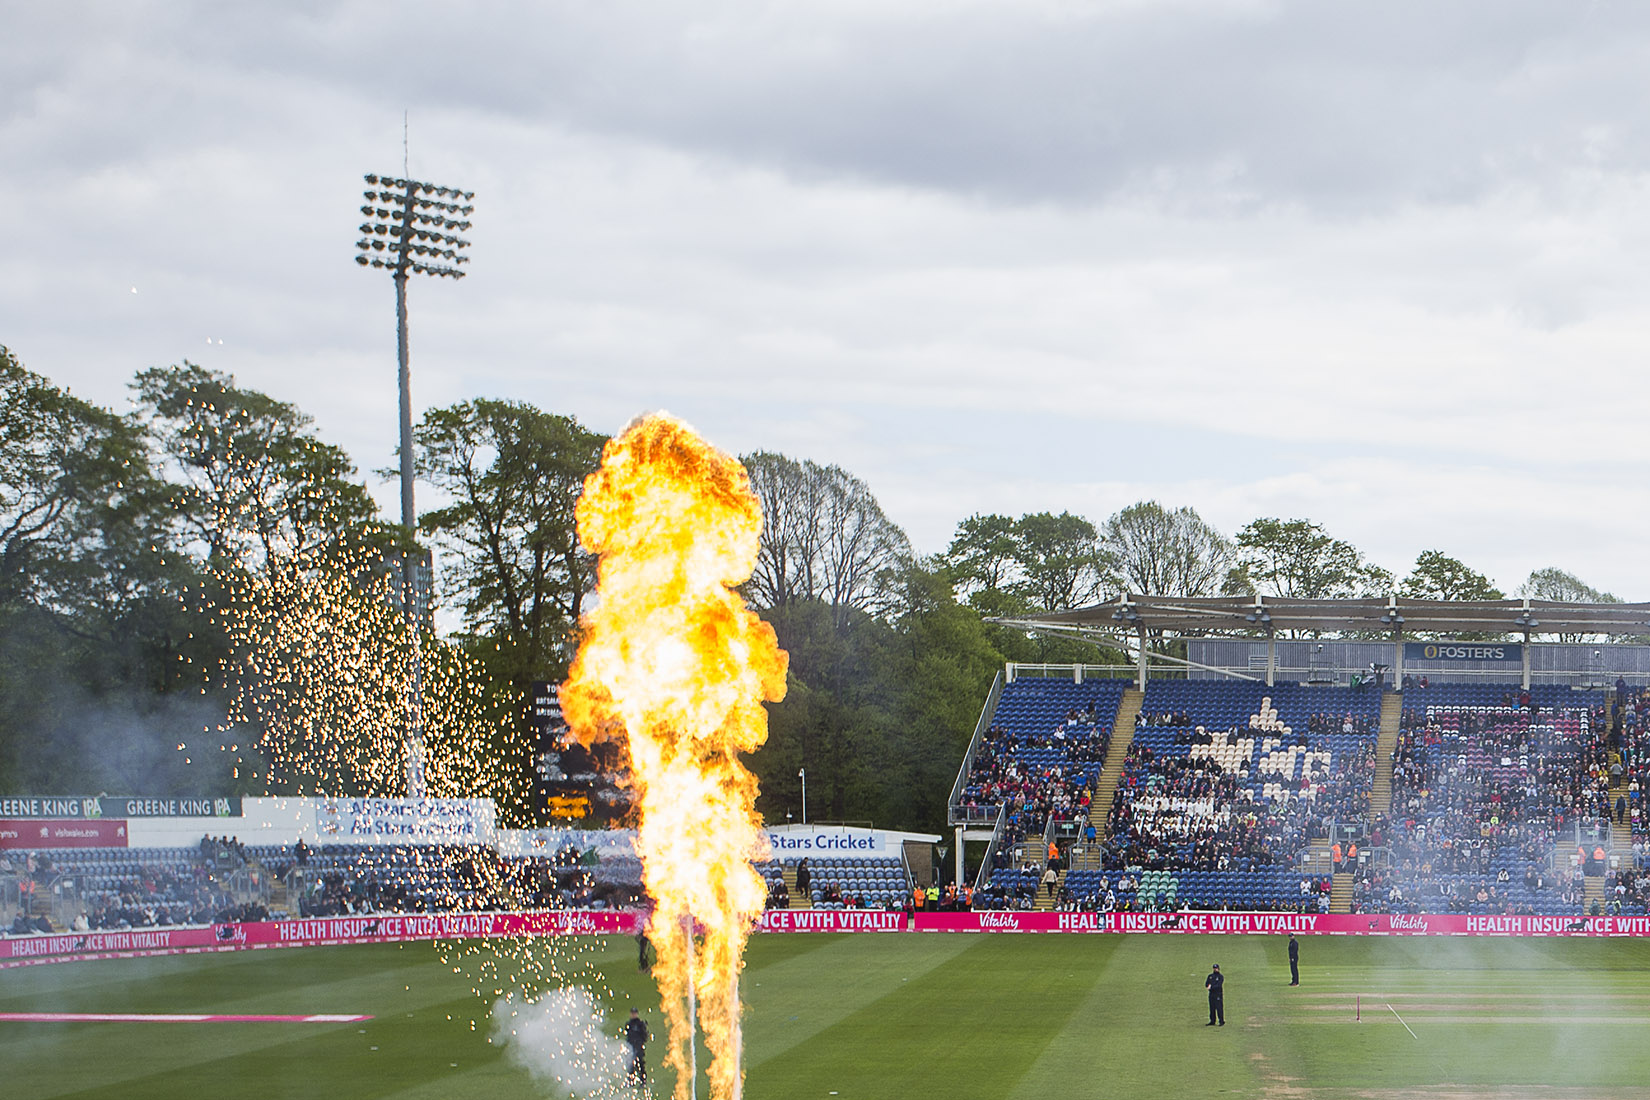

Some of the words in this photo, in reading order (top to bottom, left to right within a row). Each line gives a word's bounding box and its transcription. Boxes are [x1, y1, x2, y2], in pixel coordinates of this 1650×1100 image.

[1438, 646, 1504, 659] FOSTER'S
[42, 800, 79, 816] KING
[82, 798, 103, 817] IPA
[126, 801, 176, 816] GREENE
[180, 801, 211, 816] KING
[214, 799, 231, 815] IPA
[769, 834, 812, 850] Stars
[815, 833, 876, 850] Cricket
[280, 918, 326, 941] HEALTH
[404, 914, 439, 936] WITH
[793, 912, 834, 929] WITH
[837, 912, 901, 929] VITALITY
[979, 912, 1019, 930] Vitality
[1210, 914, 1251, 931] WITH
[1254, 914, 1318, 931] VITALITY
[1388, 915, 1428, 931] Vitality
[1466, 916, 1522, 933] HEALTH
[11, 937, 48, 957] HEALTH
[104, 933, 129, 949] WITH
[130, 931, 171, 948] VITALITY
